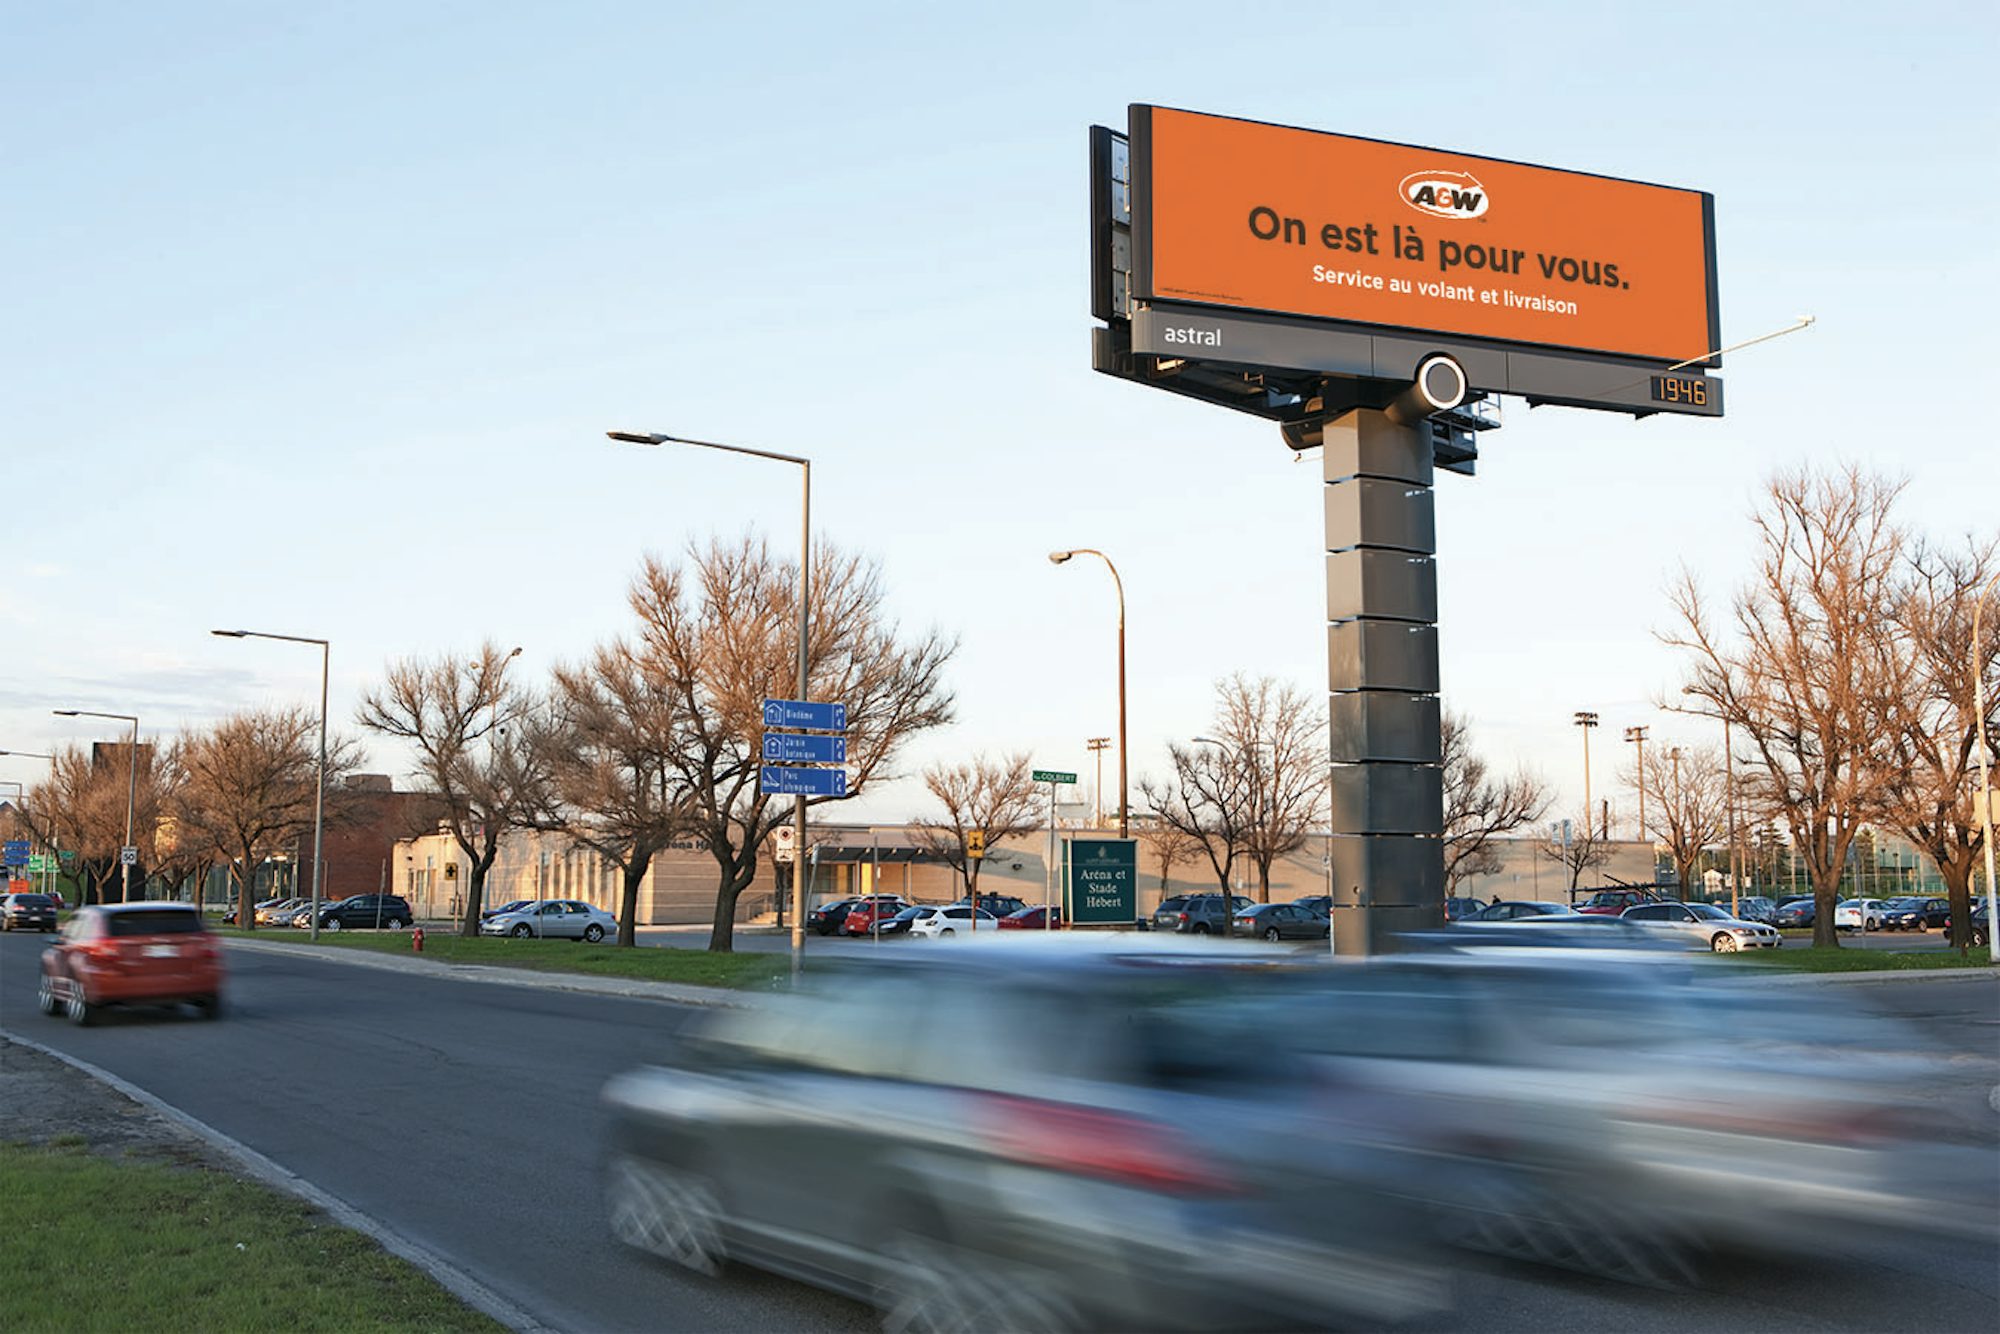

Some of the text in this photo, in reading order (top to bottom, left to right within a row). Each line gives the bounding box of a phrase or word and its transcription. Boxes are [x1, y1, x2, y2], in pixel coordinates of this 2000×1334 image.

[1412, 185, 1483, 212] A&W
[1248, 205, 1630, 290] On est là pour vous.
[1313, 264, 1577, 315] Service au volant et livraison
[1164, 327, 1221, 347] astral
[1660, 377, 1706, 405] 1946
[784, 770, 799, 780] Parc
[1040, 772, 1075, 783] COLBERT
[123, 852, 135, 861] 50
[1080, 869, 1126, 880] Aréna et
[1088, 882, 1117, 894] Stade
[1086, 896, 1122, 908] Hébert
